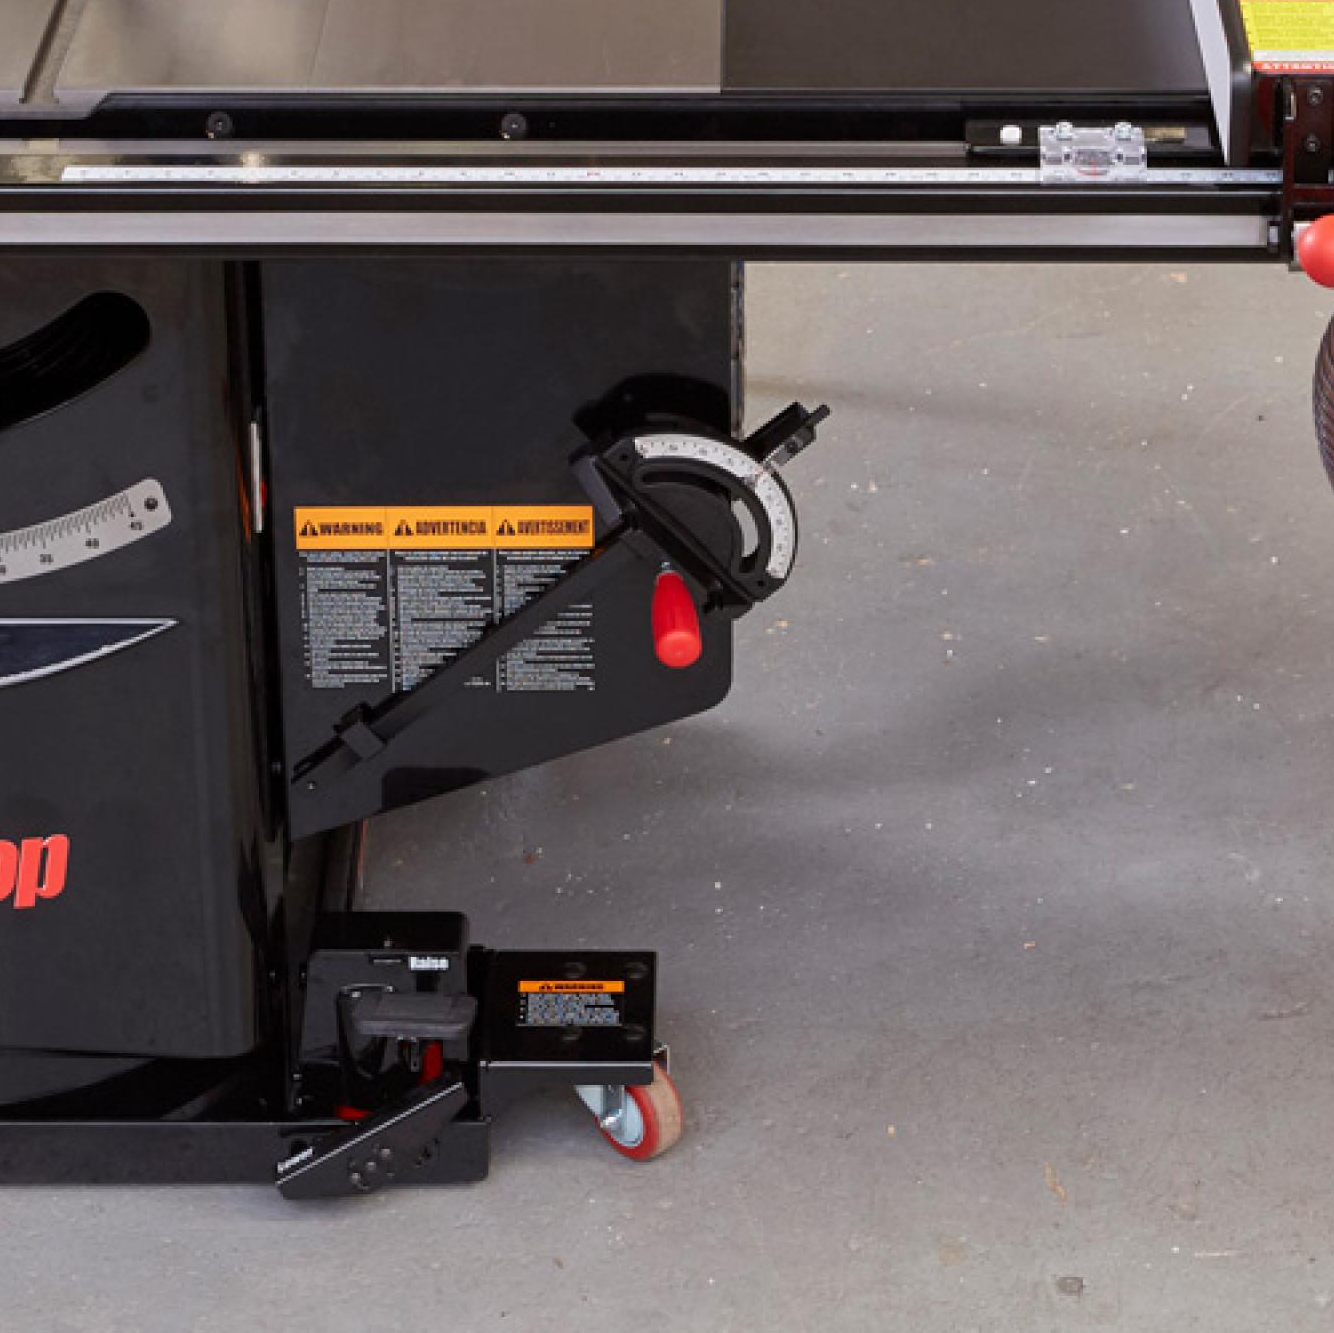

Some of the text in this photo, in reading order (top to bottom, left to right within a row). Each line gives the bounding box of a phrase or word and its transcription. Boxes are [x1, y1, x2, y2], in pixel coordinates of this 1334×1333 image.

[319, 521, 384, 536] WARNING
[415, 520, 487, 535] ADVERTENCIA
[517, 519, 590, 534] AVERTISSEMENT
